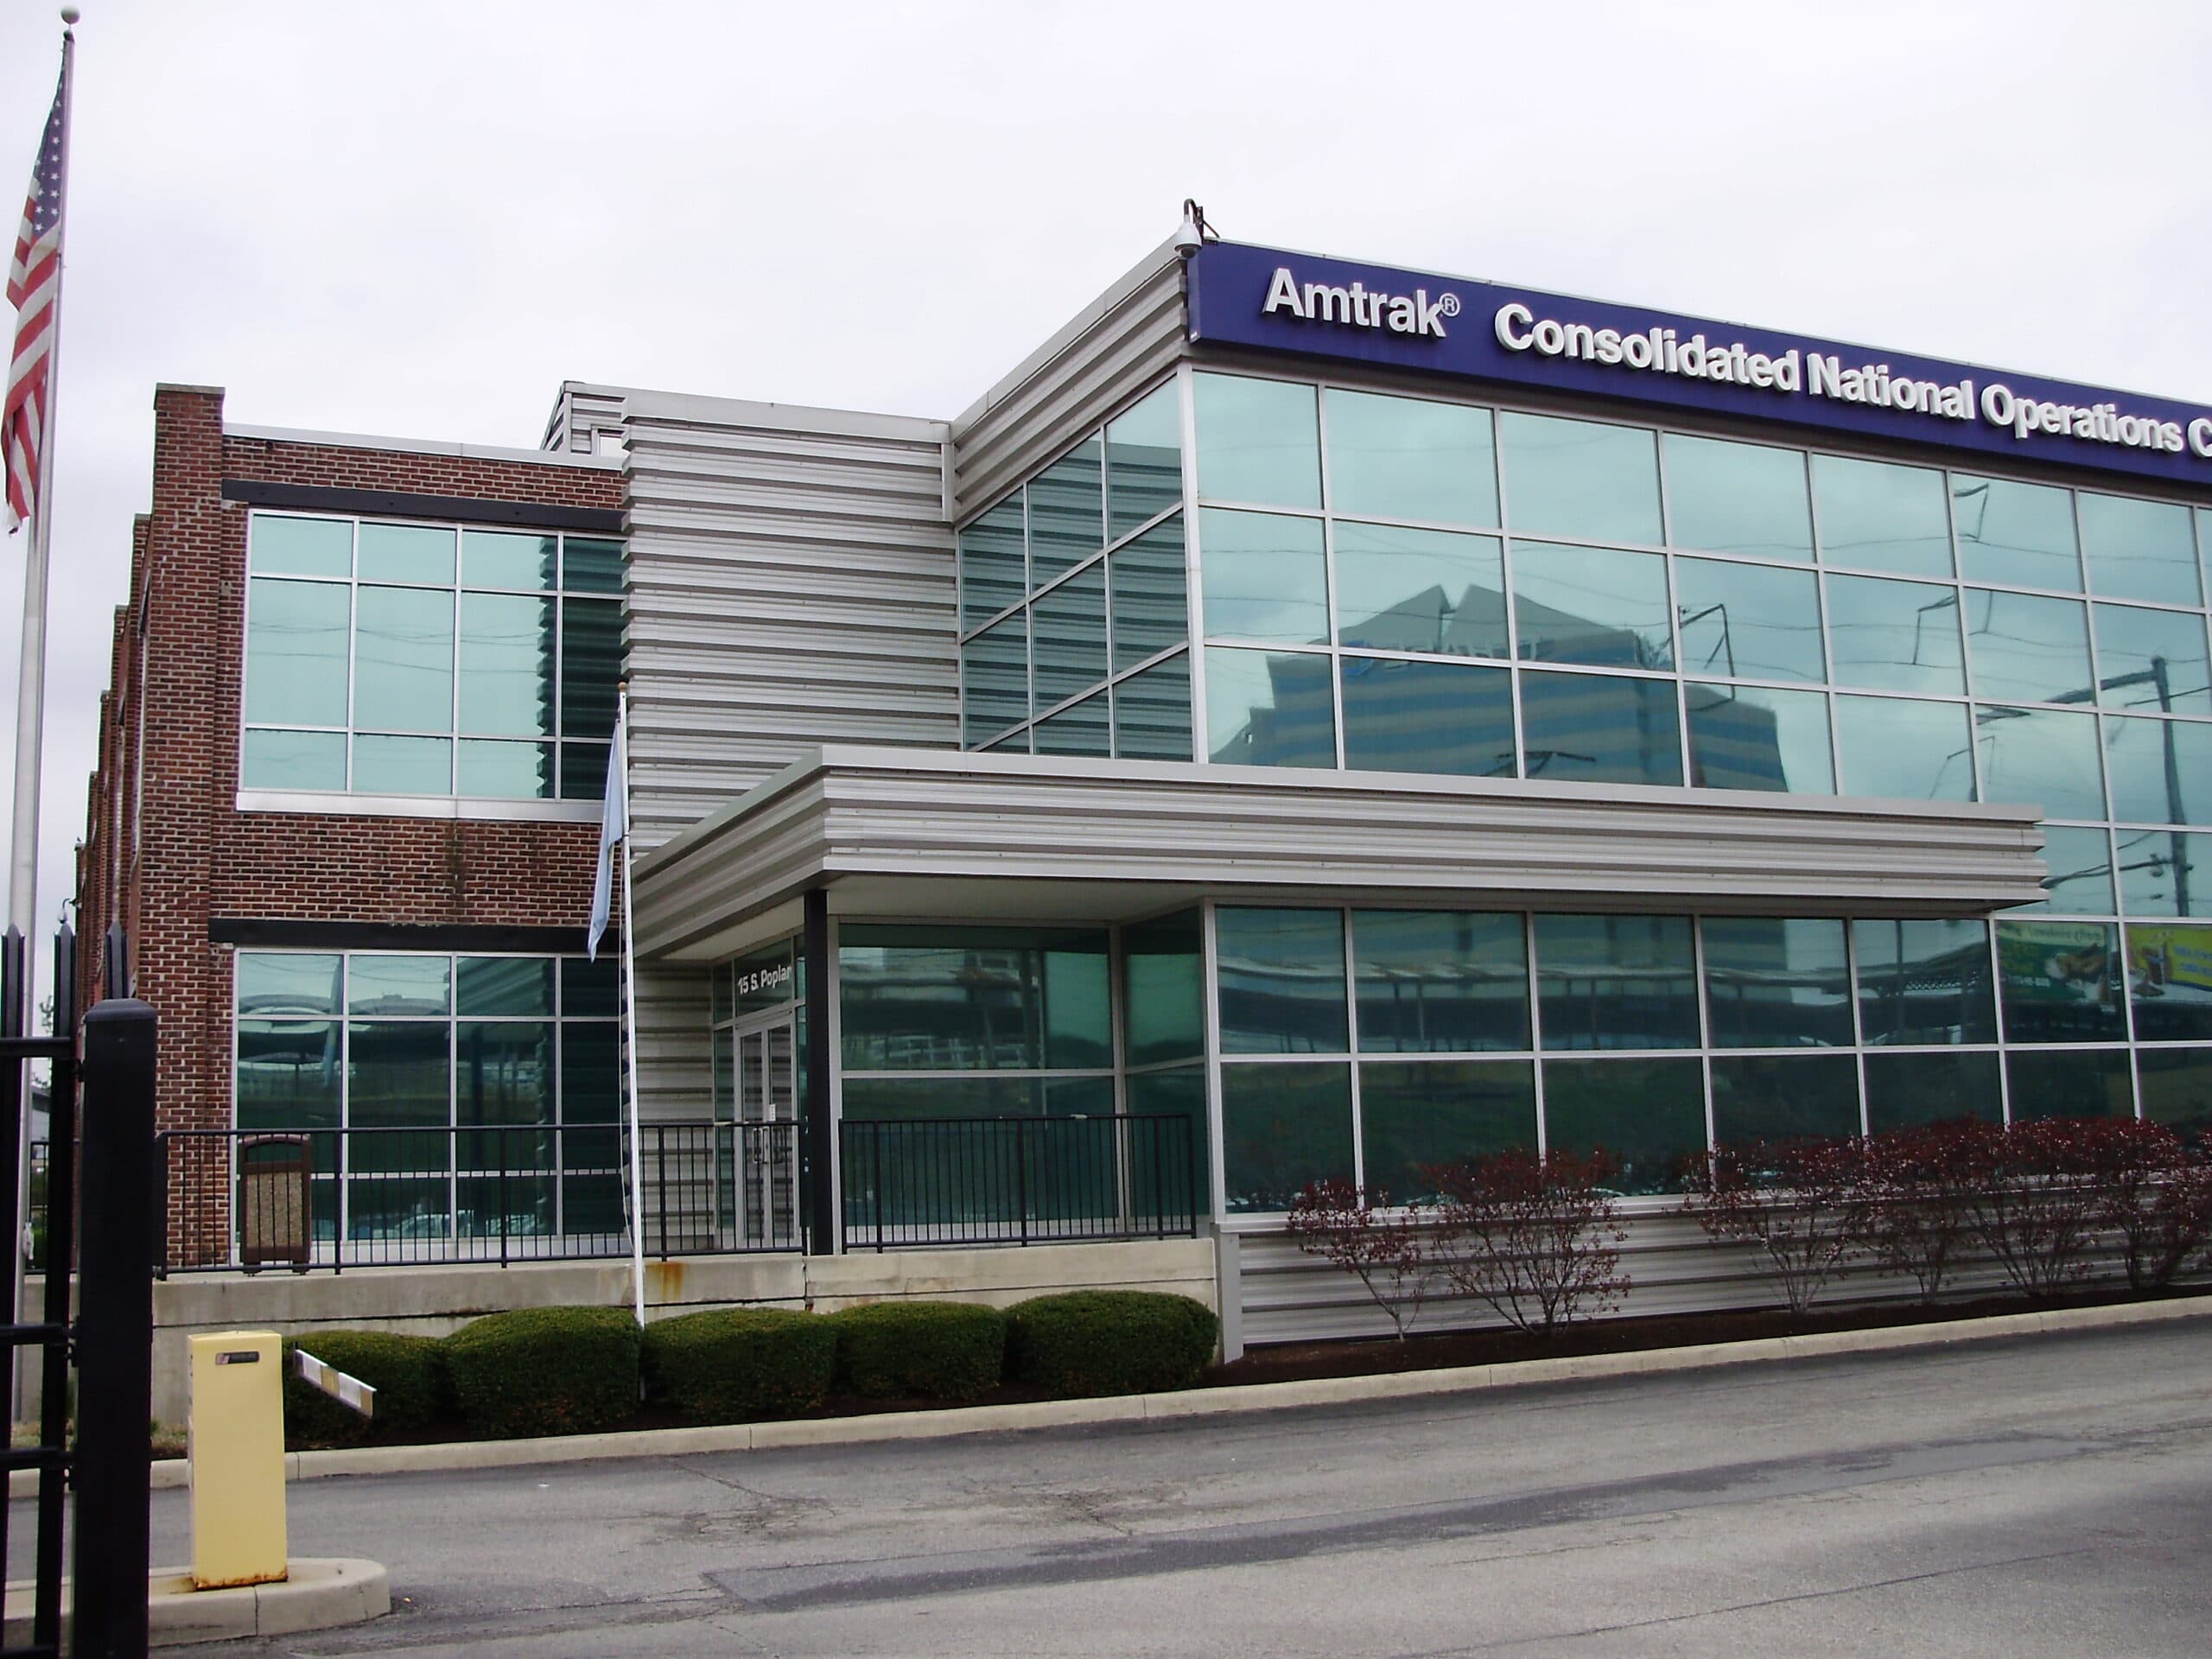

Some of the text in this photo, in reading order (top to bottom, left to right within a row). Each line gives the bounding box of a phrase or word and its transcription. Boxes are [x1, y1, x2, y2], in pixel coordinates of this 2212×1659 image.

[1495, 303, 1800, 391] Consolidated
[1807, 353, 1975, 420] National
[1981, 384, 2184, 453] Operations
[738, 975, 749, 995] 15
[760, 963, 792, 988] Poplar
